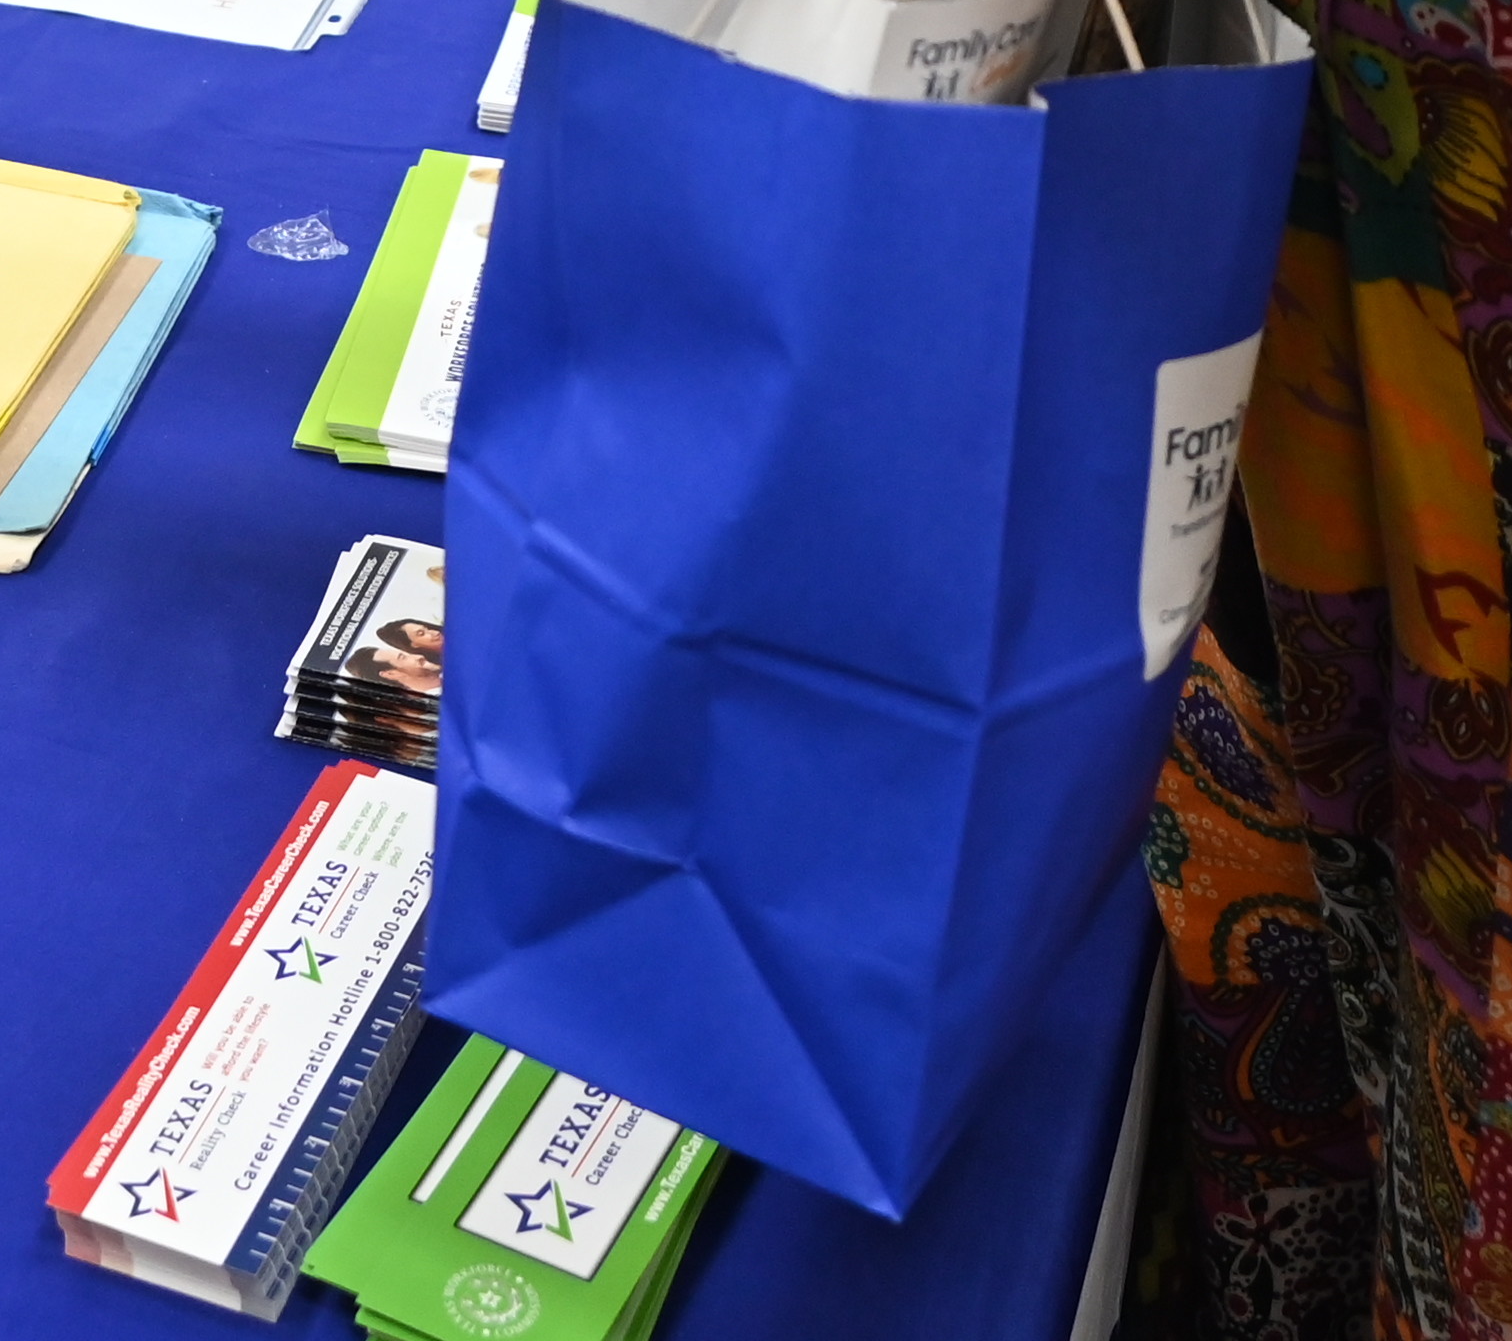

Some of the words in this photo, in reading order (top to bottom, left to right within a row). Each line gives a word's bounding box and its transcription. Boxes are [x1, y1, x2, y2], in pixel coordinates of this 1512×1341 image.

[440, 299, 463, 339] TEXAS
[328, 620, 358, 662] VOCATIONAL
[352, 571, 383, 625] REHABILITATION
[377, 549, 399, 577] SERVICES
[332, 588, 360, 629] WORKFORCE
[336, 830, 353, 852] What
[350, 817, 363, 832] are
[360, 801, 374, 820] your
[353, 832, 371, 857] career
[368, 800, 390, 834] options?
[371, 838, 392, 862] Where
[388, 824, 401, 840] are
[395, 810, 409, 826] the
[229, 799, 331, 948] www.TexasCareerCheck.com
[291, 860, 349, 928] TEXAS
[330, 903, 360, 940] Career
[352, 870, 380, 903] Check
[200, 1051, 219, 1072] Will
[214, 1035, 230, 1054] you
[223, 1023, 236, 1039] be
[232, 1006, 249, 1028] able
[242, 994, 256, 1008] to
[220, 1050, 243, 1078] afford
[236, 1034, 250, 1053] the
[245, 1001, 272, 1037] lifestyle
[238, 1063, 255, 1084] you
[249, 1037, 270, 1065] want?
[81, 1004, 202, 1180] www.TexasRealityCheck.com
[233, 1132, 279, 1193] Career
[268, 1026, 339, 1131] Information
[331, 968, 375, 1027] Hotline
[149, 1077, 214, 1158] TEXAS
[188, 1127, 227, 1172] Reality
[216, 1090, 248, 1128] Check
[539, 1081, 612, 1169] TEXAS
[585, 1141, 623, 1187] Career
